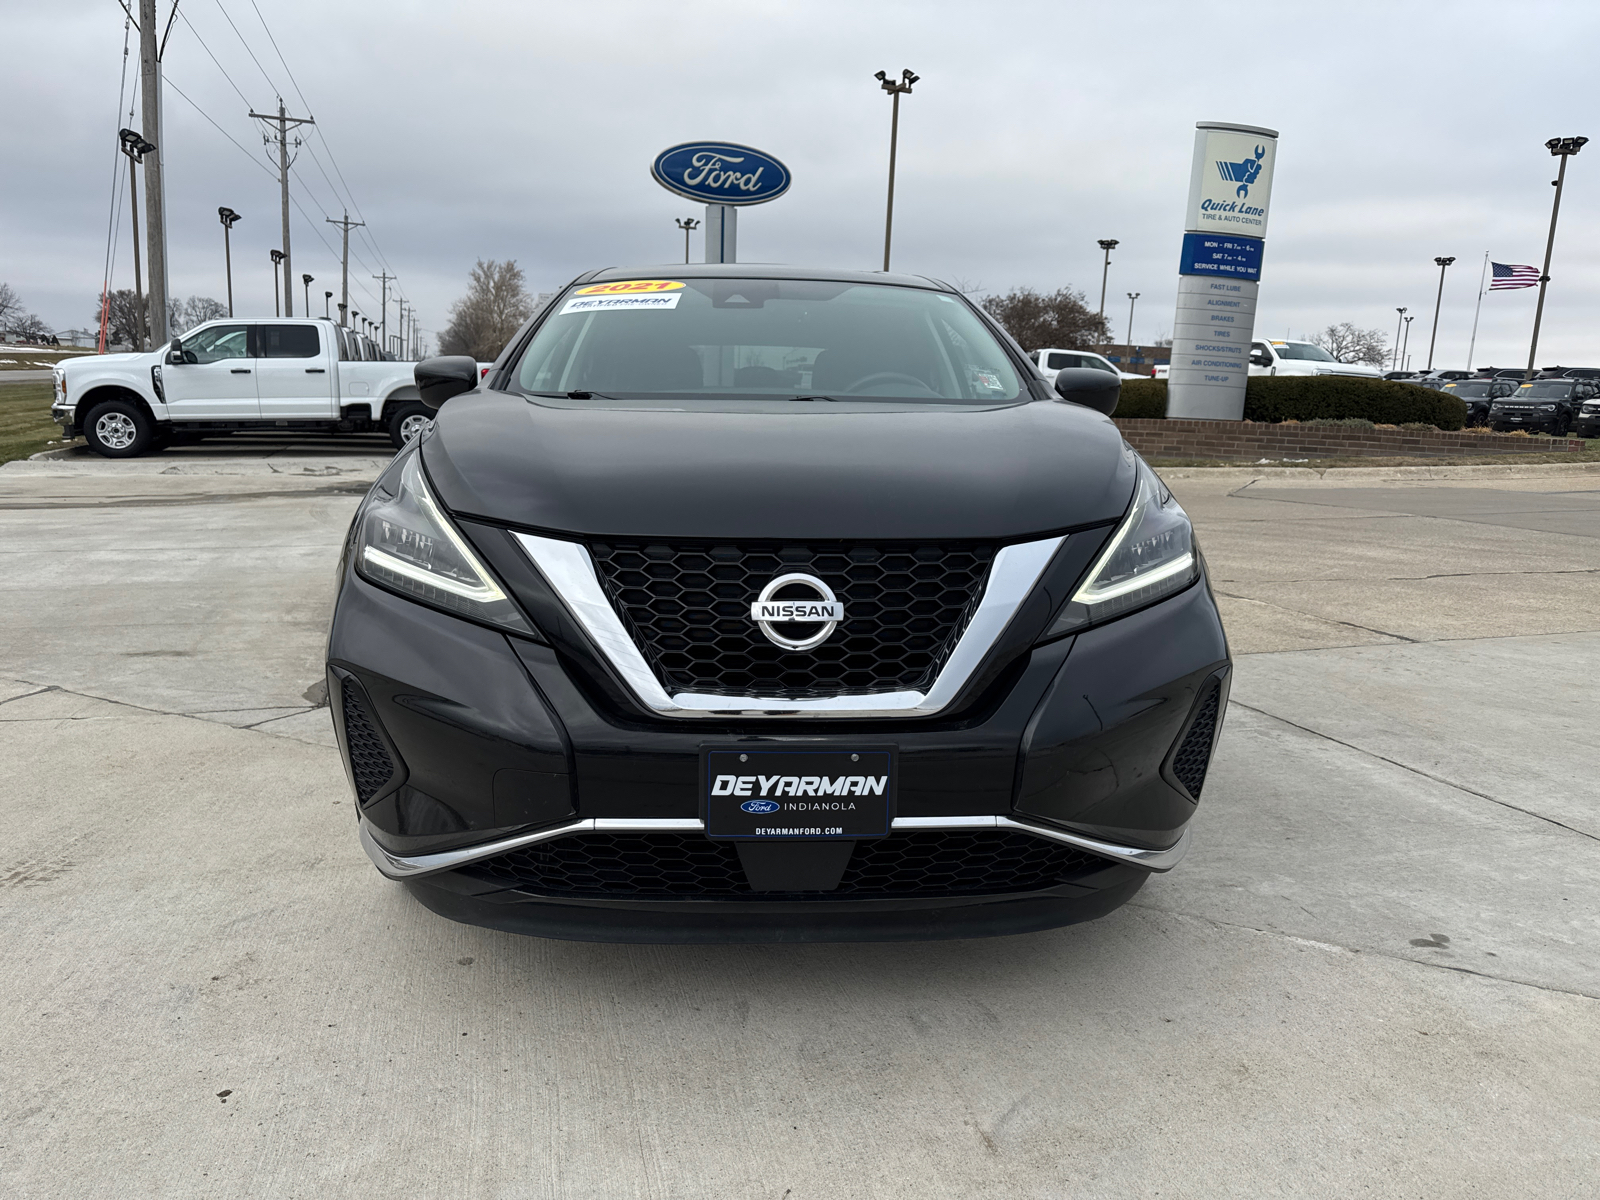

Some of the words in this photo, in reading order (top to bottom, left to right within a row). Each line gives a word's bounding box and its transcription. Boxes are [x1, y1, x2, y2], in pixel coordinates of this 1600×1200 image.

[683, 151, 764, 191] Ford
[1201, 199, 1238, 212] Quick
[1238, 203, 1264, 216] Lane
[1202, 213, 1217, 221] TIRE
[1242, 217, 1262, 226] CENTER
[585, 282, 672, 294] 2021
[570, 298, 672, 307] DEYARMAN
[1207, 300, 1241, 308] ALIGNMENT
[1211, 315, 1235, 323] BRAKES
[1195, 345, 1242, 354] SHOCKS/STRUTS
[1203, 360, 1242, 369] CONDITIONING
[761, 606, 835, 618] NISSAN
[711, 775, 888, 796] DEYARMAN
[748, 802, 772, 813] Ford
[785, 803, 856, 811] INDIANOLA
